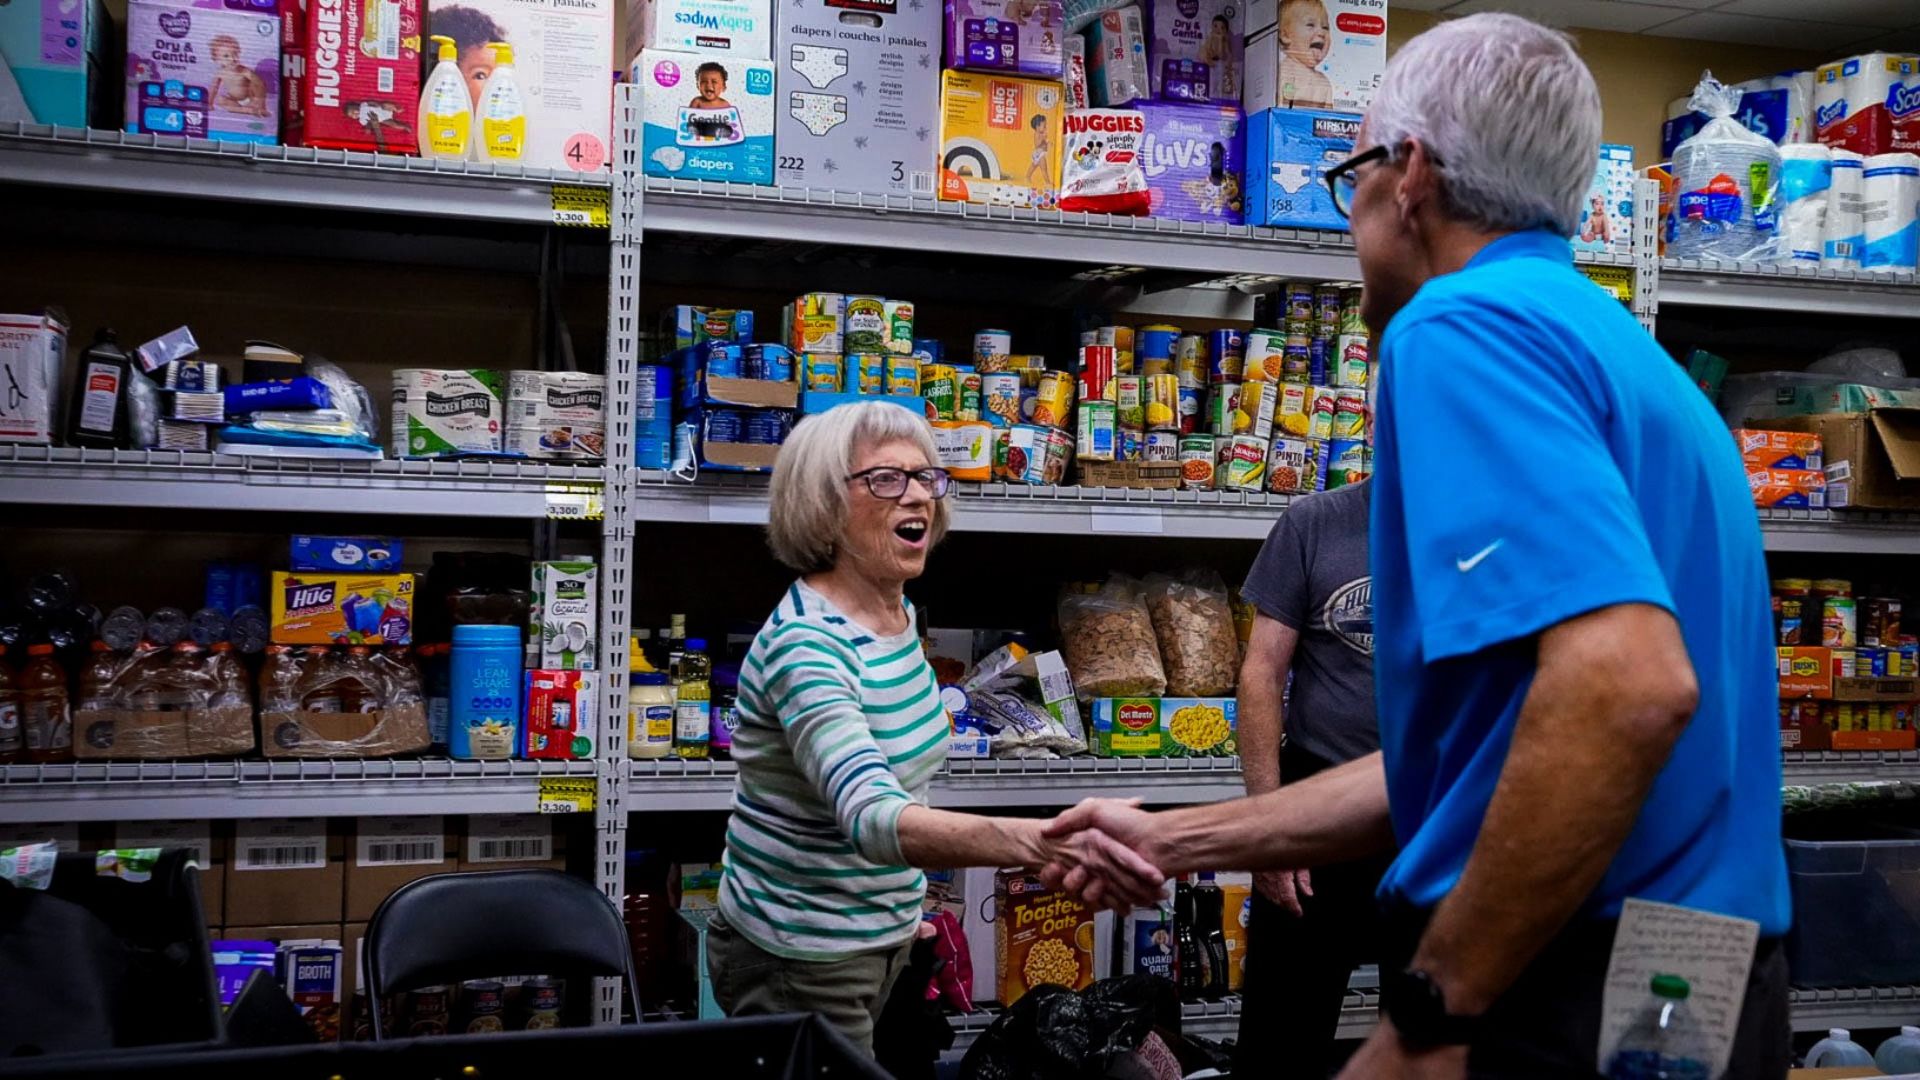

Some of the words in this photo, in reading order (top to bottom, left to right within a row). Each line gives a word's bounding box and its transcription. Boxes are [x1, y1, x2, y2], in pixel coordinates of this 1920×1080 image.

[345, 0, 358, 48] snuggler
[674, 11, 718, 30] Wipes
[720, 14, 753, 32] Baby
[1174, 20, 1191, 29] Dry
[791, 25, 832, 39] diapers
[838, 30, 881, 42] couches
[888, 35, 927, 48] pañales
[1171, 29, 1203, 39] Gentle
[155, 39, 180, 53] Dry
[184, 42, 193, 52] &
[151, 50, 197, 63] Gentle
[313, 0, 341, 107] HUGGIES
[985, 46, 995, 60] 3
[344, 49, 356, 75] little
[749, 71, 770, 83] 120
[992, 87, 1005, 123] hello
[1005, 88, 1018, 124] bello
[1893, 88, 1920, 113] Sco
[165, 112, 179, 128] 4
[688, 113, 730, 124] Gentle
[1063, 114, 1144, 134] HUGGIES
[1316, 120, 1360, 133] KIRKLAN
[1106, 134, 1136, 142] simply
[568, 142, 583, 162] 4
[1144, 133, 1208, 176] Luvs
[688, 157, 734, 171] diapers
[779, 156, 805, 170] 222
[891, 160, 904, 182] 3
[946, 179, 960, 189] 58
[555, 213, 584, 222] 3,300
[741, 315, 748, 325] 8
[923, 385, 953, 397] CARROTS
[428, 401, 457, 413] CHICKEN
[460, 398, 488, 410] BREAST
[548, 394, 575, 405] CHICKEN
[1149, 446, 1175, 455] PINTO
[1276, 451, 1302, 461] PINTO
[550, 506, 578, 515] 3,300
[398, 582, 411, 592] 20
[382, 623, 390, 637] 1
[1793, 661, 1818, 671] BUSH'S
[477, 668, 509, 679] LEAN
[472, 679, 512, 688] SHAKE
[1227, 703, 1235, 712] 8
[1132, 711, 1153, 719] Monte
[543, 803, 571, 812] 3,300
[1042, 916, 1077, 934] Oats
[298, 966, 332, 980] BROTH
[1149, 965, 1170, 975] OATS
